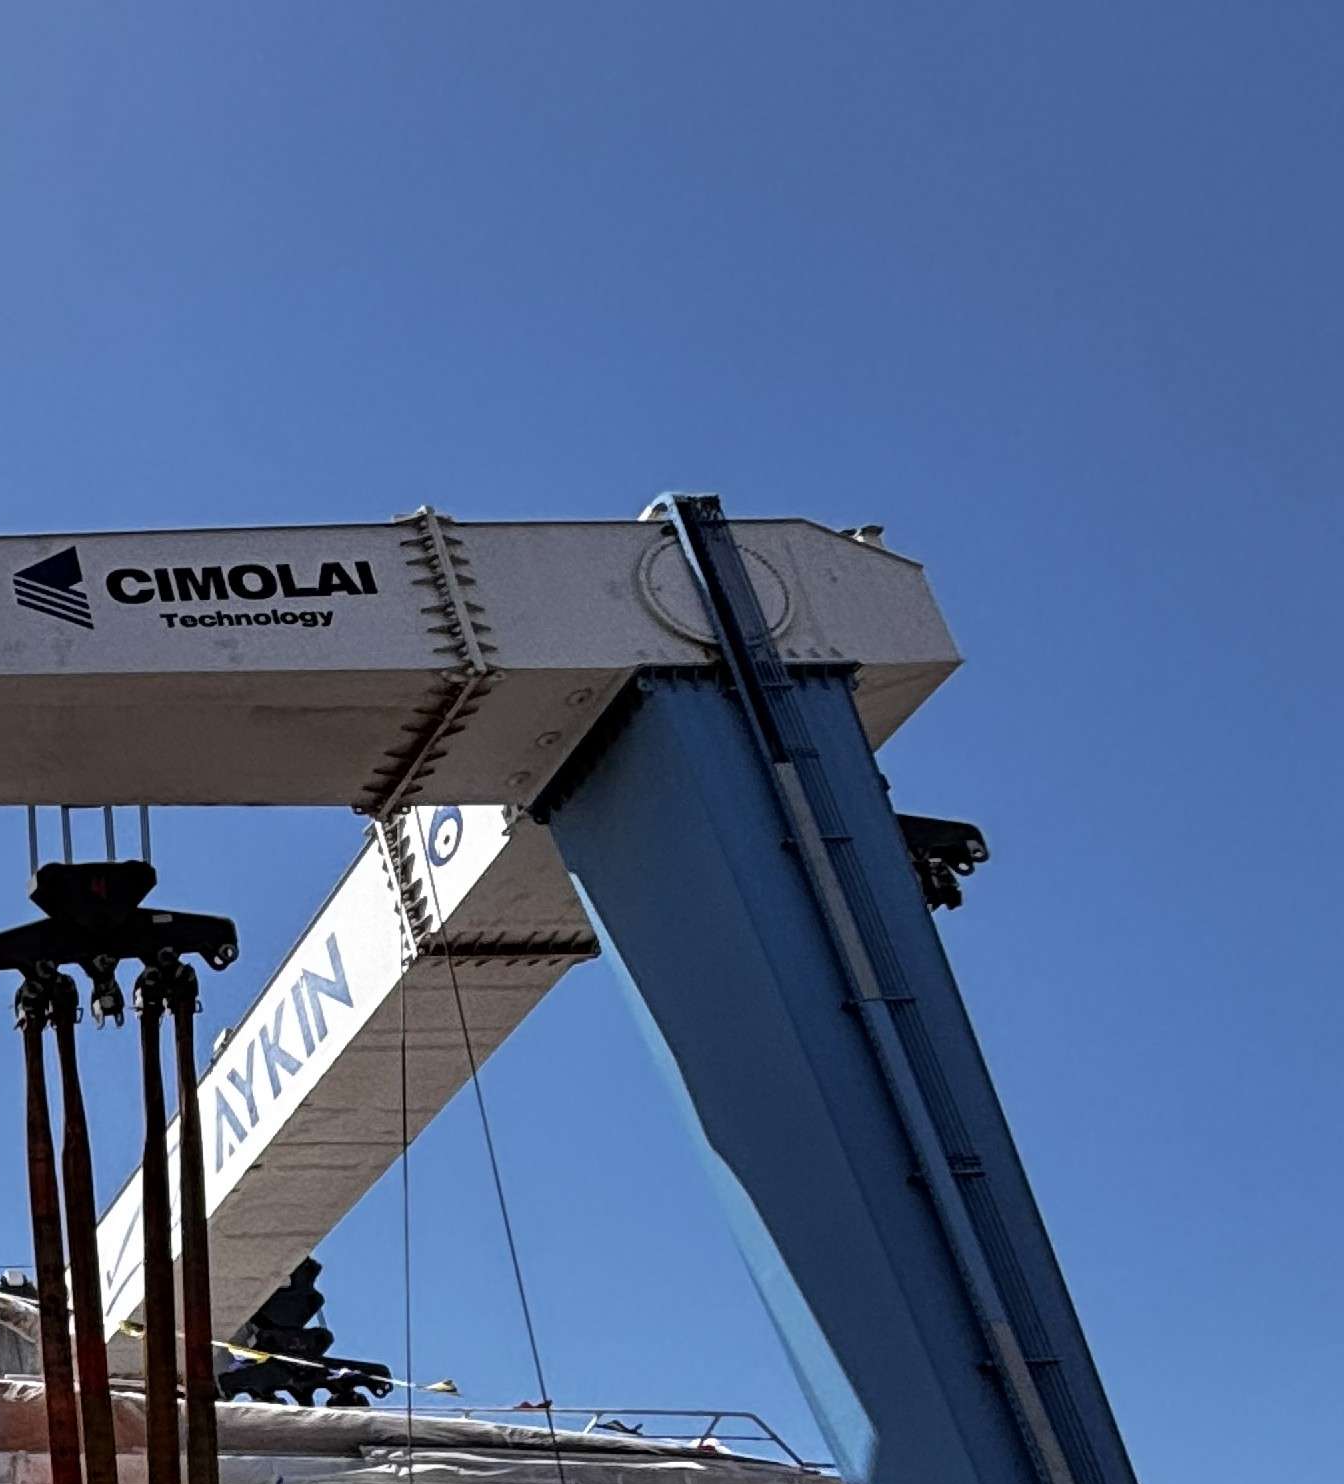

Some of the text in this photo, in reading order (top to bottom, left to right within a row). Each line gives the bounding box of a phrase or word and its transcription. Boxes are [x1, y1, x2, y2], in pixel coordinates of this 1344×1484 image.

[105, 560, 378, 605] CIMOLAI
[159, 609, 334, 629] Technology
[215, 932, 354, 1174] AYKIN
